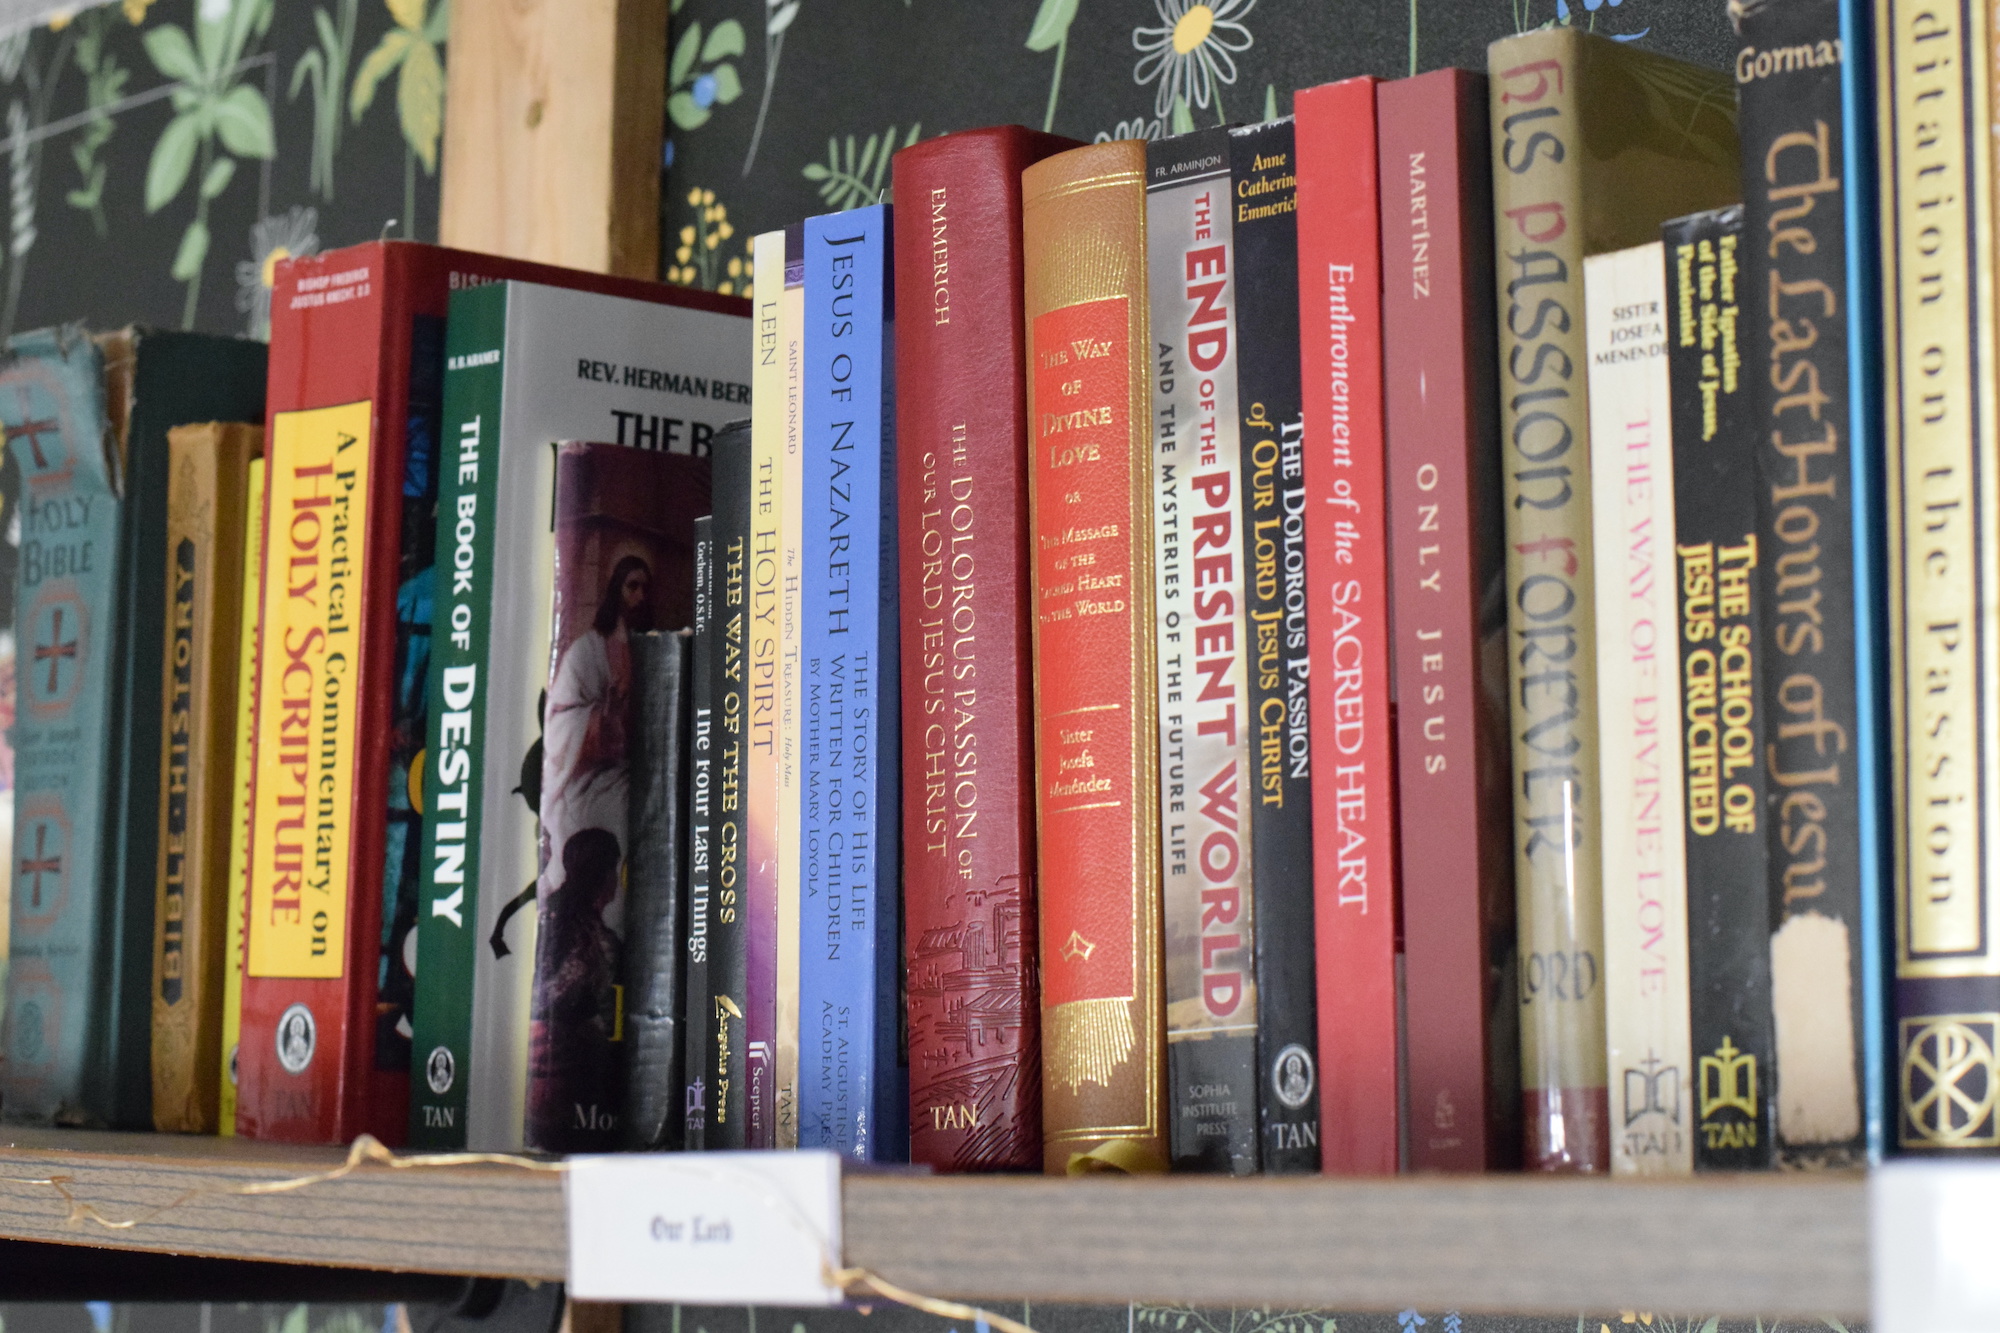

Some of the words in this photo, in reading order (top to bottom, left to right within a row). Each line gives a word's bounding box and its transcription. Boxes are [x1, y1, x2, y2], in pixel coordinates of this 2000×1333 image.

[1155, 167, 1169, 178] FR.
[1170, 154, 1222, 175] ARMINJON
[1251, 153, 1286, 172] Anne
[1765, 119, 1840, 259] The
[1195, 191, 1212, 242] THE
[823, 231, 865, 338] JESUS
[931, 186, 950, 327] EMMERICH
[1699, 240, 1716, 262] of
[1700, 265, 1717, 300] the
[1719, 234, 1739, 302] Father
[761, 301, 776, 366] LEEN
[1186, 245, 1228, 372] END
[1701, 303, 1719, 350] Side
[577, 358, 619, 384] REV.
[623, 366, 708, 399] HERMAN
[788, 341, 797, 383] SAINT
[831, 354, 852, 402] OF
[1158, 342, 1175, 394] AND
[1329, 263, 1356, 467] Enthronement
[1702, 353, 1720, 377] of
[1768, 268, 1837, 422] Last
[1199, 379, 1215, 411] OF
[1246, 402, 1274, 431] of
[1922, 345, 1946, 425] on
[337, 431, 358, 454] A
[458, 414, 481, 486] THE
[788, 388, 797, 456] LEONARD
[952, 420, 967, 468] THE
[1042, 406, 1114, 438] DIVINE
[1050, 443, 1101, 469] LOVE
[1160, 404, 1176, 454] THE
[1200, 418, 1217, 467] THE
[1281, 411, 1304, 480] THE
[759, 457, 773, 516] THE
[923, 452, 936, 503] OUR
[1251, 439, 1280, 511] OUR
[1626, 408, 1652, 505] THE
[27, 496, 94, 535] HOLY
[829, 421, 855, 637] NAZARETH
[1326, 479, 1360, 514] of
[1416, 463, 1441, 593] ONLY
[1924, 467, 1961, 579] the
[24, 539, 94, 588] BIBLE
[288, 457, 335, 607] HOLY
[328, 470, 357, 635] Practical
[453, 494, 477, 596] BOOK
[921, 509, 943, 609] LORD
[1161, 464, 1179, 600] MYSTERIES
[1254, 514, 1281, 600] LORD
[1334, 519, 1361, 565] the
[1629, 518, 1654, 602] WAY
[1771, 421, 1838, 656] Hours
[696, 541, 706, 592] Cochem,
[727, 536, 743, 607] THE
[755, 528, 776, 626] HOLY
[950, 476, 976, 680] DOLOROUS
[1077, 573, 1123, 592] HEART
[1282, 486, 1307, 650] DOLOROUS
[1677, 541, 1716, 643] JESUS
[1718, 532, 1758, 619] THE
[450, 603, 472, 651] OF
[1075, 599, 1125, 616] WORLD
[1165, 611, 1181, 643] OF
[1191, 471, 1236, 747] PRESENT
[725, 613, 741, 682] WAY
[810, 658, 821, 678] BY
[854, 650, 868, 698] THE
[919, 617, 945, 715] JESUS
[1167, 654, 1182, 703] THE
[1251, 607, 1283, 690] JESUS
[1331, 580, 1365, 754] SACRED
[169, 569, 195, 795] HISTORY
[724, 692, 740, 734] OF
[753, 637, 774, 756] SPIRIT
[829, 653, 845, 768] WRITTEN
[1416, 628, 1447, 775] JESUS
[1719, 624, 1755, 779] SCHOOL
[1777, 673, 1848, 756] of
[809, 684, 821, 764] MOTHER
[853, 706, 869, 782] STORY
[1060, 729, 1094, 745] Sister
[1287, 655, 1310, 779] PASSION
[1686, 649, 1721, 837] CRUCIFIED
[270, 626, 326, 927] SCRIPTURE
[308, 651, 347, 895] Commentary
[722, 741, 738, 812] THE
[953, 688, 978, 839] PASSION
[1058, 749, 1095, 775] Josefa
[1168, 714, 1184, 813] FUTURE
[1260, 697, 1286, 809] CHRIST
[1633, 695, 1662, 856] DIVINE
[1926, 621, 1964, 904] Passion
[431, 663, 476, 928] DESTINY
[695, 760, 711, 816] Four
[808, 770, 821, 822] MARY
[828, 778, 843, 825] FOR
[853, 790, 867, 822] OF
[925, 724, 947, 857] CHRIST
[1723, 784, 1755, 834] OF
[694, 825, 710, 873] Last
[808, 829, 820, 898] LOYOLA
[852, 831, 868, 874] HIS
[958, 849, 972, 880] OF
[1170, 824, 1186, 876] LIFE
[1335, 760, 1368, 915] HEART
[163, 830, 188, 980] BIBLE
[720, 821, 738, 924] CROSS
[828, 832, 844, 960] CHILDREN
[1198, 759, 1242, 1017] WORLD
[311, 910, 329, 957] on
[688, 880, 709, 964] Things
[852, 884, 868, 931] LIFE
[1637, 870, 1666, 998] LOVE
[717, 1008, 731, 1075] Angelus
[822, 1000, 834, 1093] ACADEMY
[838, 1006, 850, 1030] ST.
[423, 1105, 455, 1127] TAN
[717, 1079, 729, 1123] Press
[751, 1066, 764, 1130] Scepter
[781, 1082, 792, 1128] TAN
[836, 1037, 849, 1148] AUGUSTINE
[930, 1103, 977, 1131] TAN
[1182, 1101, 1238, 1118] INSTITUTE
[1189, 1082, 1231, 1099] SOPHIA
[1196, 1121, 1228, 1135] PRESS
[1271, 1121, 1317, 1149] TAN
[1701, 1120, 1757, 1149] TAN
[650, 1216, 685, 1243] Our
[690, 1216, 734, 1245] Lord
